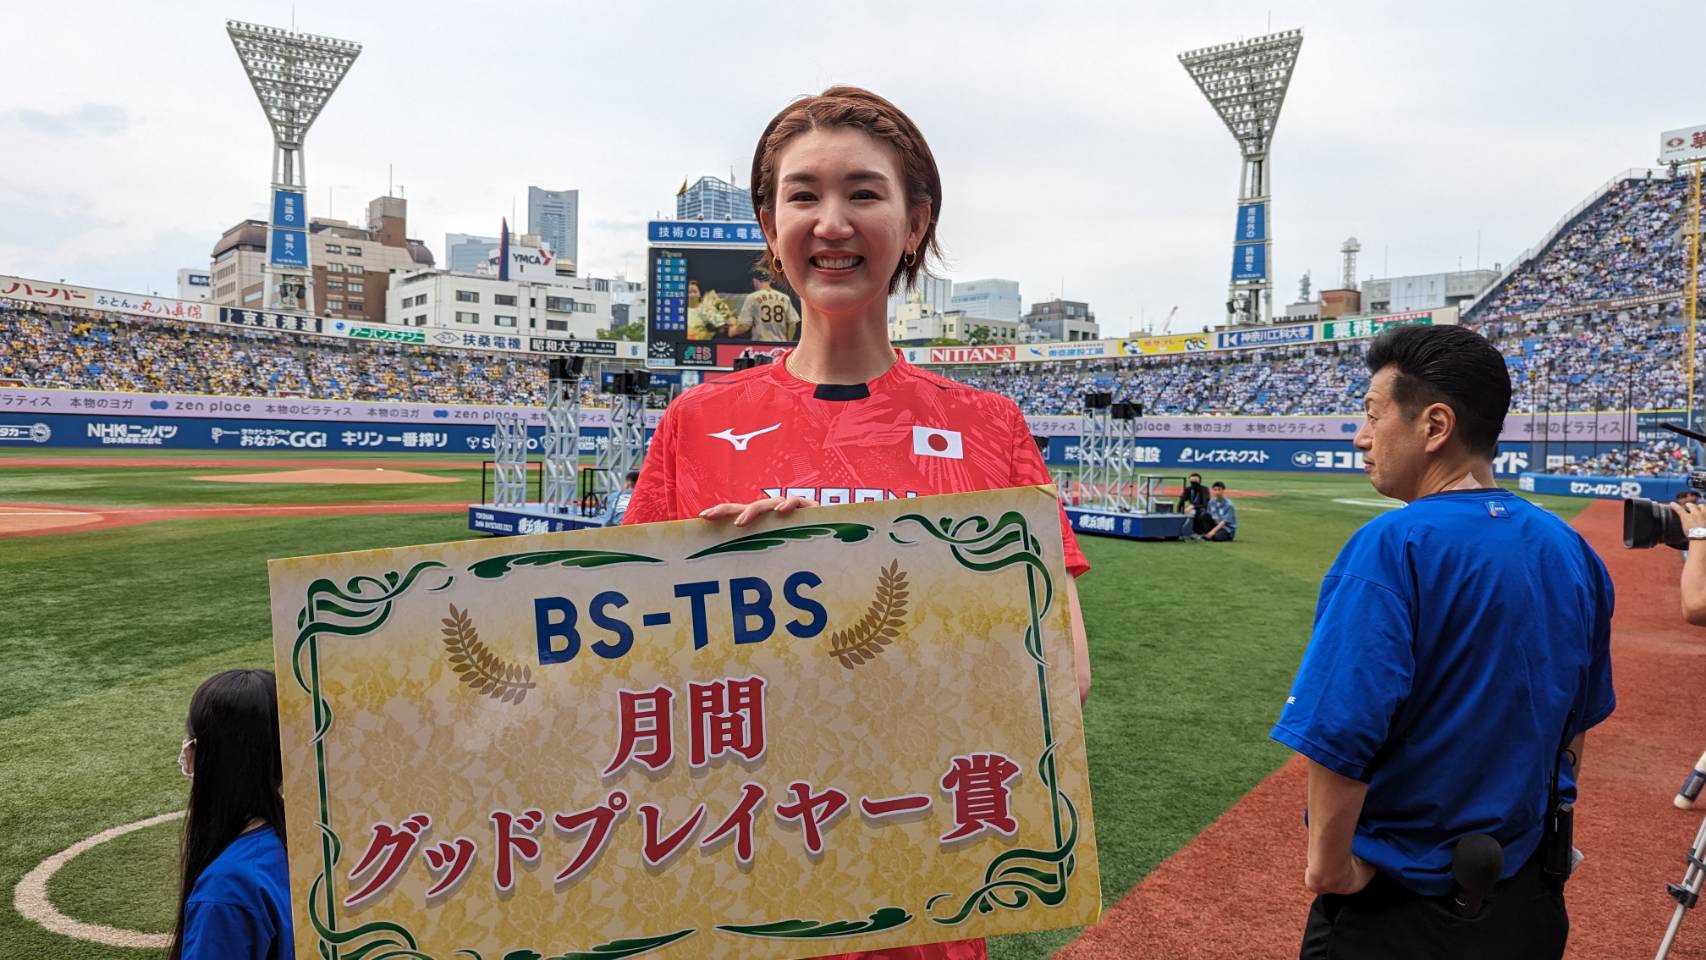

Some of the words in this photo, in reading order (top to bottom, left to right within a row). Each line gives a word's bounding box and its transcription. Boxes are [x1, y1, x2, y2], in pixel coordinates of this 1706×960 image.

[512, 253, 541, 265] YMCA
[760, 305, 784, 323] 38
[931, 348, 998, 362] NITTAN
[0, 394, 52, 407] ラティス
[70, 396, 134, 409] 本物のヨガ
[175, 401, 204, 410] zen
[210, 401, 252, 413] place
[367, 408, 420, 418] 本物のヨガ
[454, 410, 479, 419] zen
[534, 571, 828, 665] BS-TBS
[603, 674, 767, 777] 月間
[343, 753, 1022, 908] グッドプレイヤー賞
